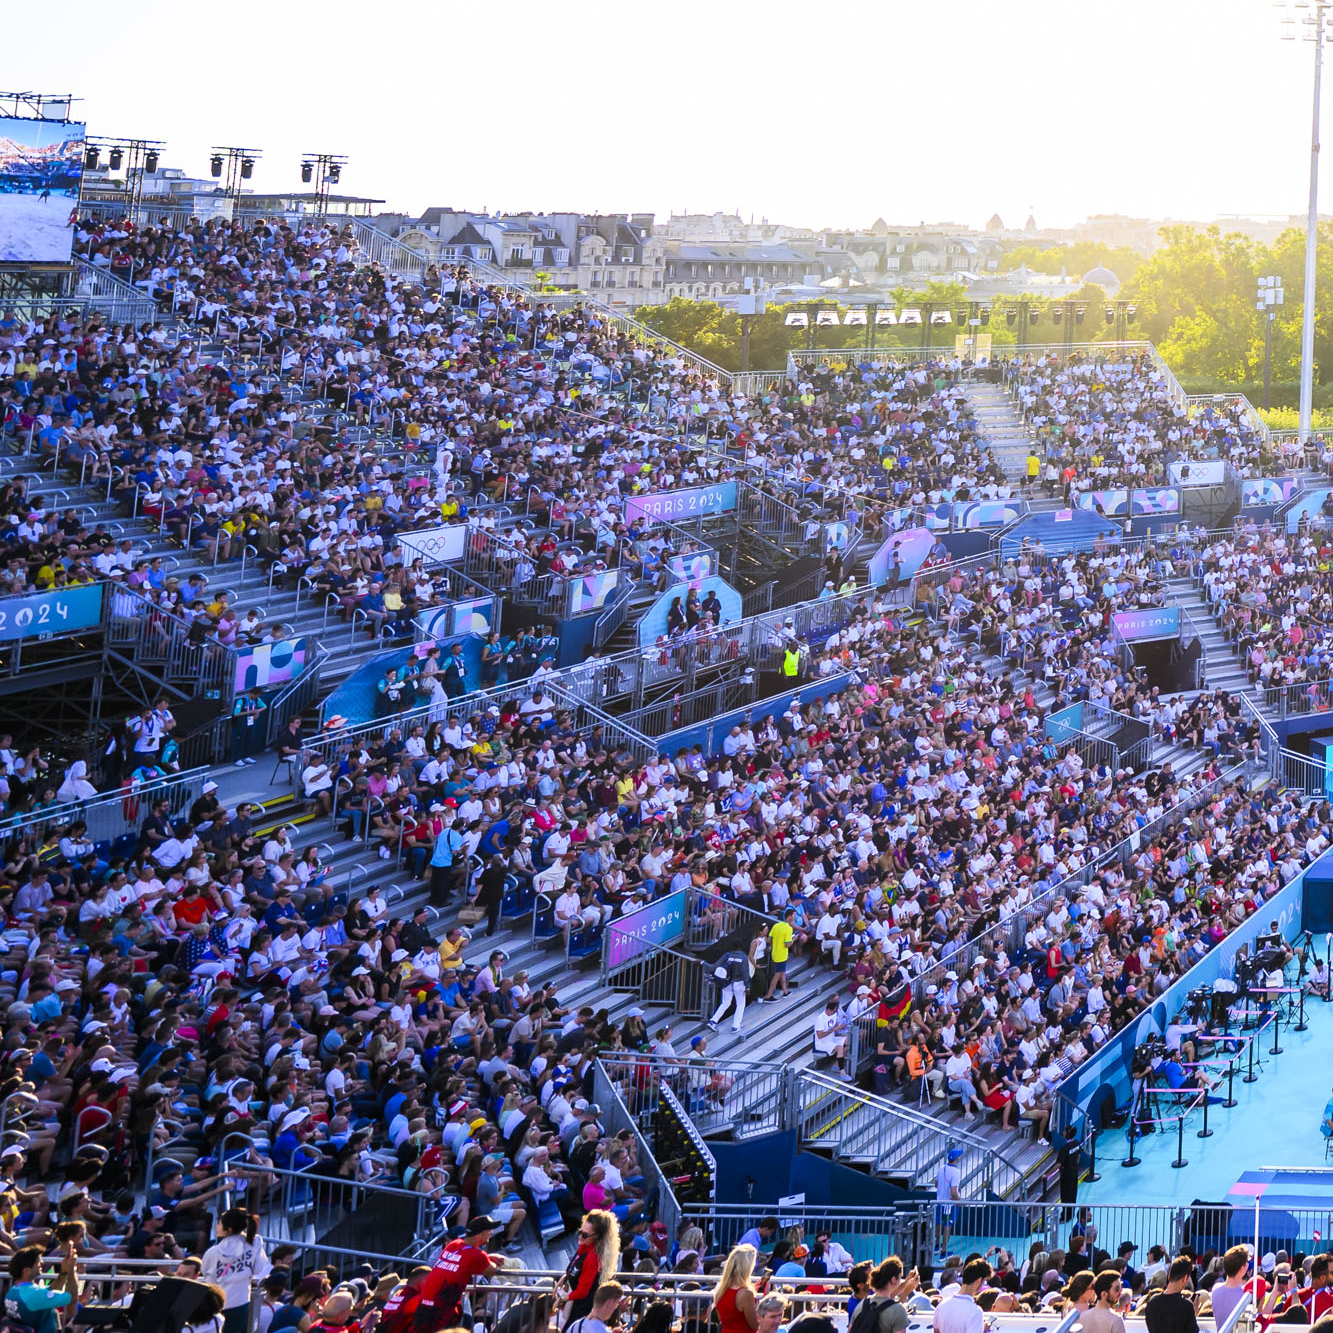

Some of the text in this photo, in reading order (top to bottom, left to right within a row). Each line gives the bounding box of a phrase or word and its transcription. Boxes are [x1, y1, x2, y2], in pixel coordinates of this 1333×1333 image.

[688, 491, 722, 510] 2024
[1149, 617, 1174, 626] 2024
[651, 910, 680, 932] 2024
[1262, 898, 1300, 934] 024
